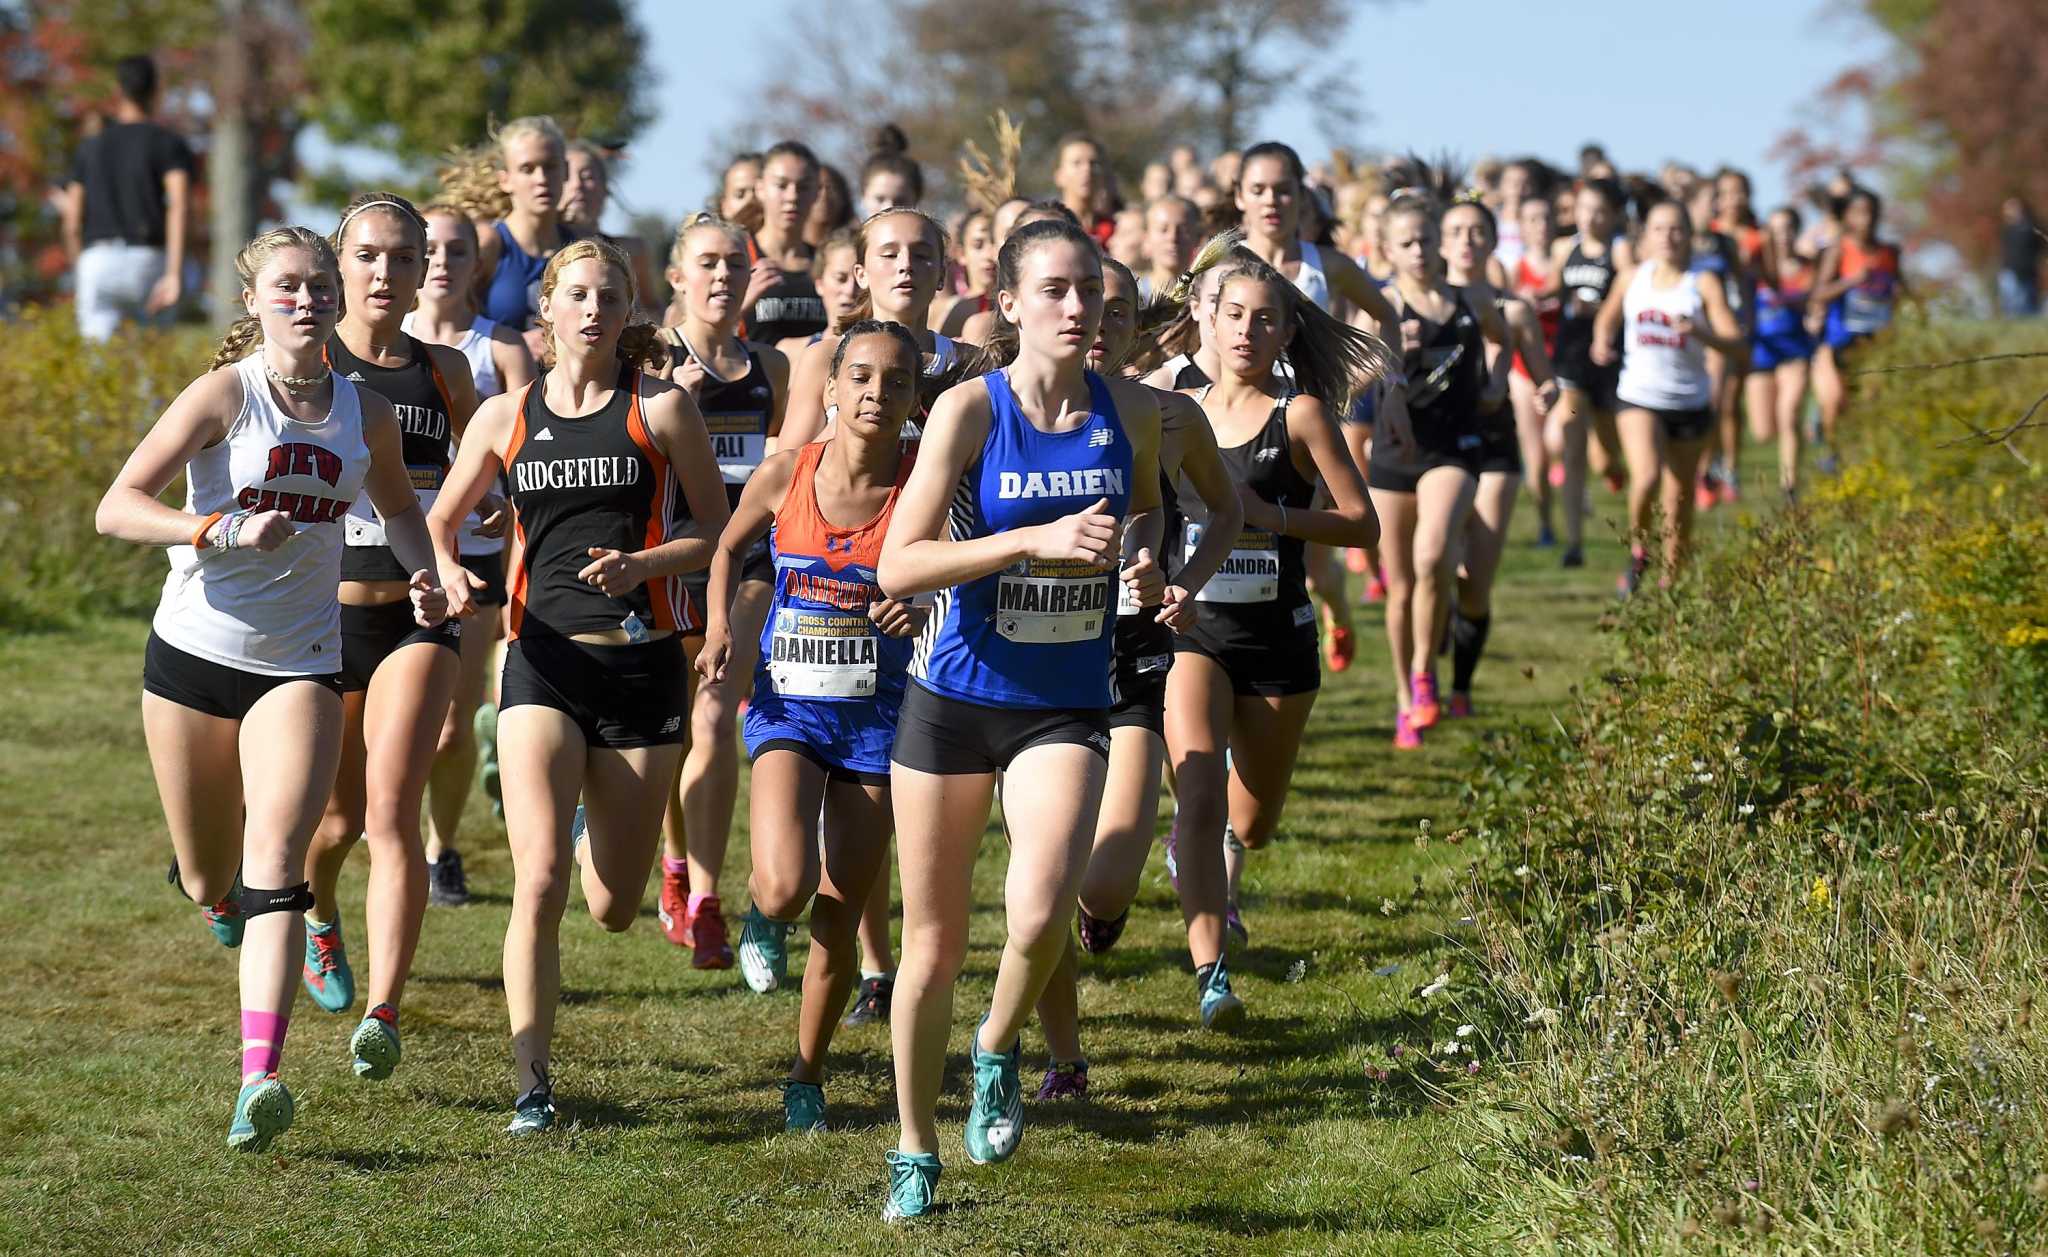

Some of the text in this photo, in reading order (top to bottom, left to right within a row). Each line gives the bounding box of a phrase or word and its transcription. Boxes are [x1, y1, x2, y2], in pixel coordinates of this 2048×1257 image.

[264, 443, 342, 488] NEW
[516, 457, 640, 492] RIDGEFIELD
[999, 468, 1124, 498] DARIEN
[1000, 582, 1107, 613] MAIREAD
[797, 615, 870, 627] CROSS COUNTRY
[797, 627, 870, 637] CHAMPIONSHIPS
[773, 636, 876, 665] DANIELLA
